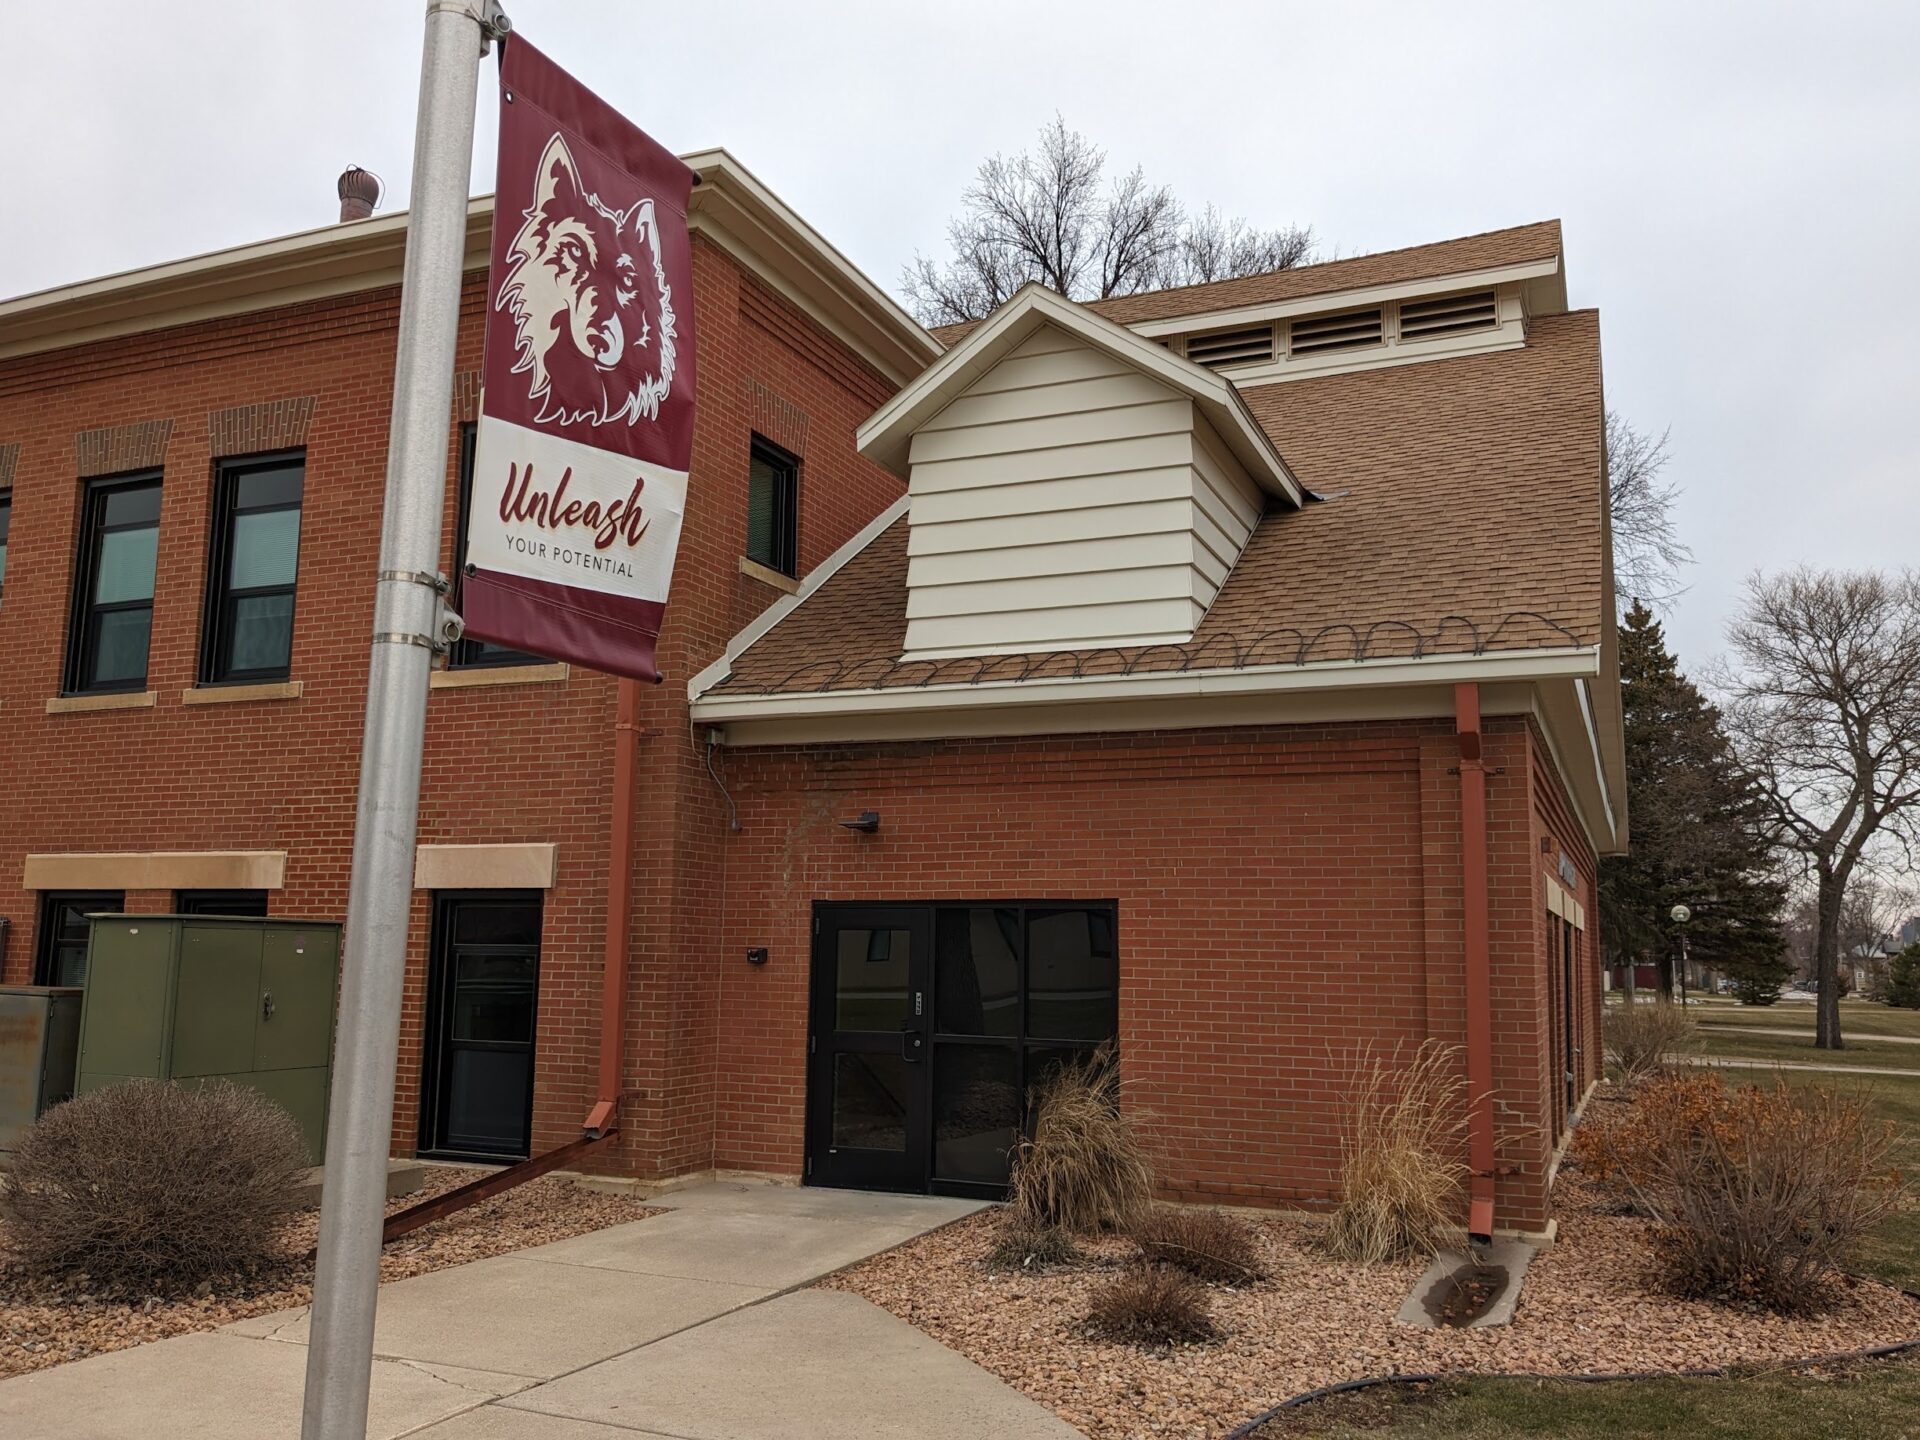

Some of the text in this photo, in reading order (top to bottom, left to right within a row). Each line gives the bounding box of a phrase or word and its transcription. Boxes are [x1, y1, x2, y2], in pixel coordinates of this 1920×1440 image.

[500, 462, 651, 550] Unleash
[506, 535, 633, 578] YOUR POTENTIAL
